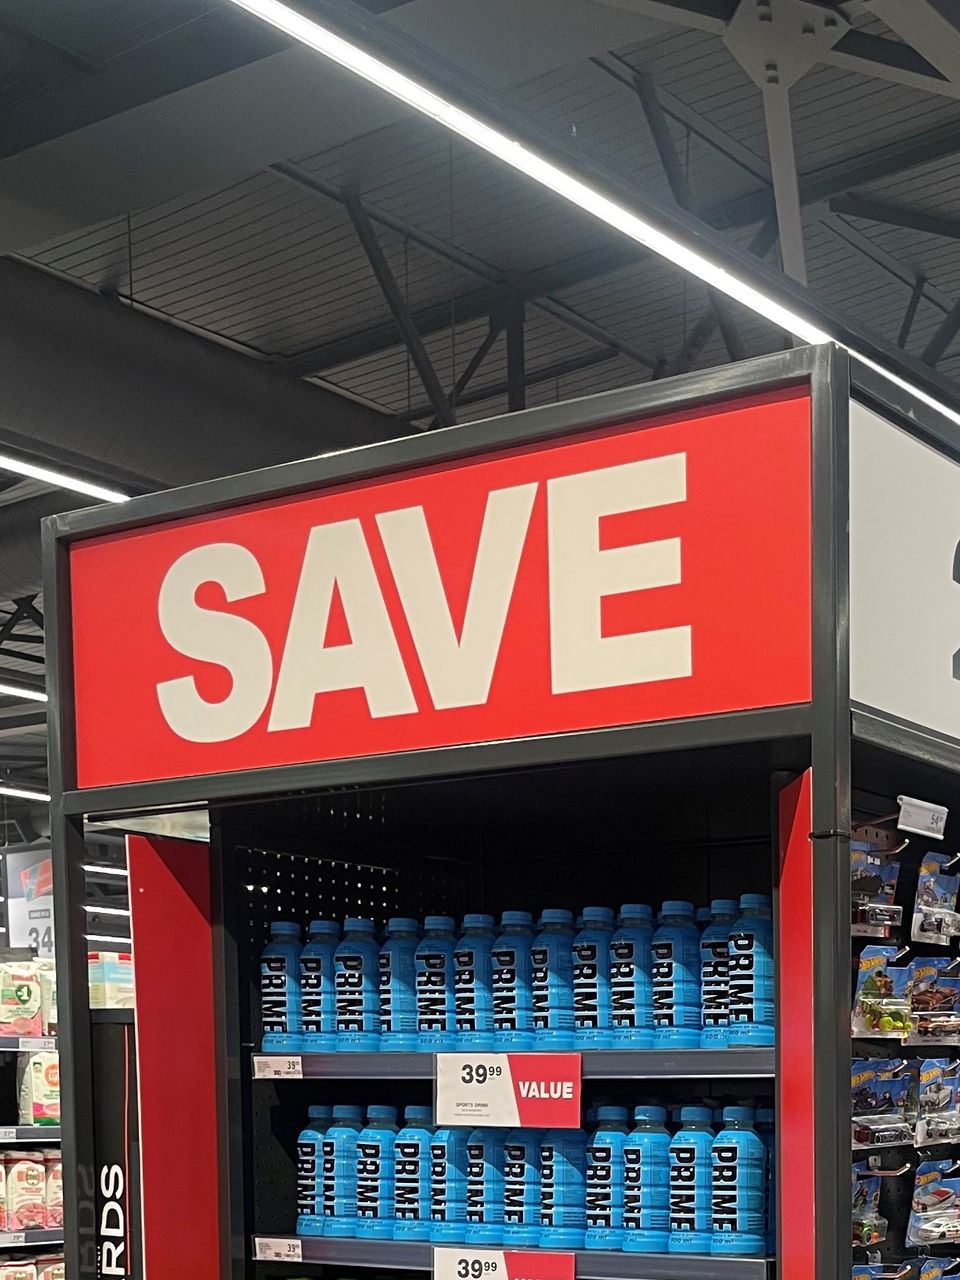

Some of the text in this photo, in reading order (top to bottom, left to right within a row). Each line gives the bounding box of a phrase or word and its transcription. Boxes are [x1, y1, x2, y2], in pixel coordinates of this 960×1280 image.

[156, 452, 692, 744] SAVE
[261, 955, 288, 1033] PRIME
[300, 956, 322, 1033] PRIME
[335, 955, 364, 1033] PRIME
[416, 953, 447, 1032] PRIME
[454, 951, 476, 1032] PRIME
[492, 950, 517, 1032] PRIME
[572, 943, 598, 1029] PRIME
[610, 941, 636, 1028] PRIME
[652, 942, 674, 1029] PRIME
[701, 941, 729, 1028] PRIME
[728, 933, 754, 1024] PRIME
[519, 1081, 573, 1099] VALUE
[356, 1141, 381, 1219] PRIME
[394, 1140, 420, 1220] PRIME
[467, 1143, 485, 1222] PRIME
[505, 1144, 526, 1225] PRIME
[586, 1145, 612, 1228] PRIME
[624, 1147, 641, 1229] PRIME
[670, 1146, 696, 1231] PRIME
[712, 1146, 739, 1232] PRIME
